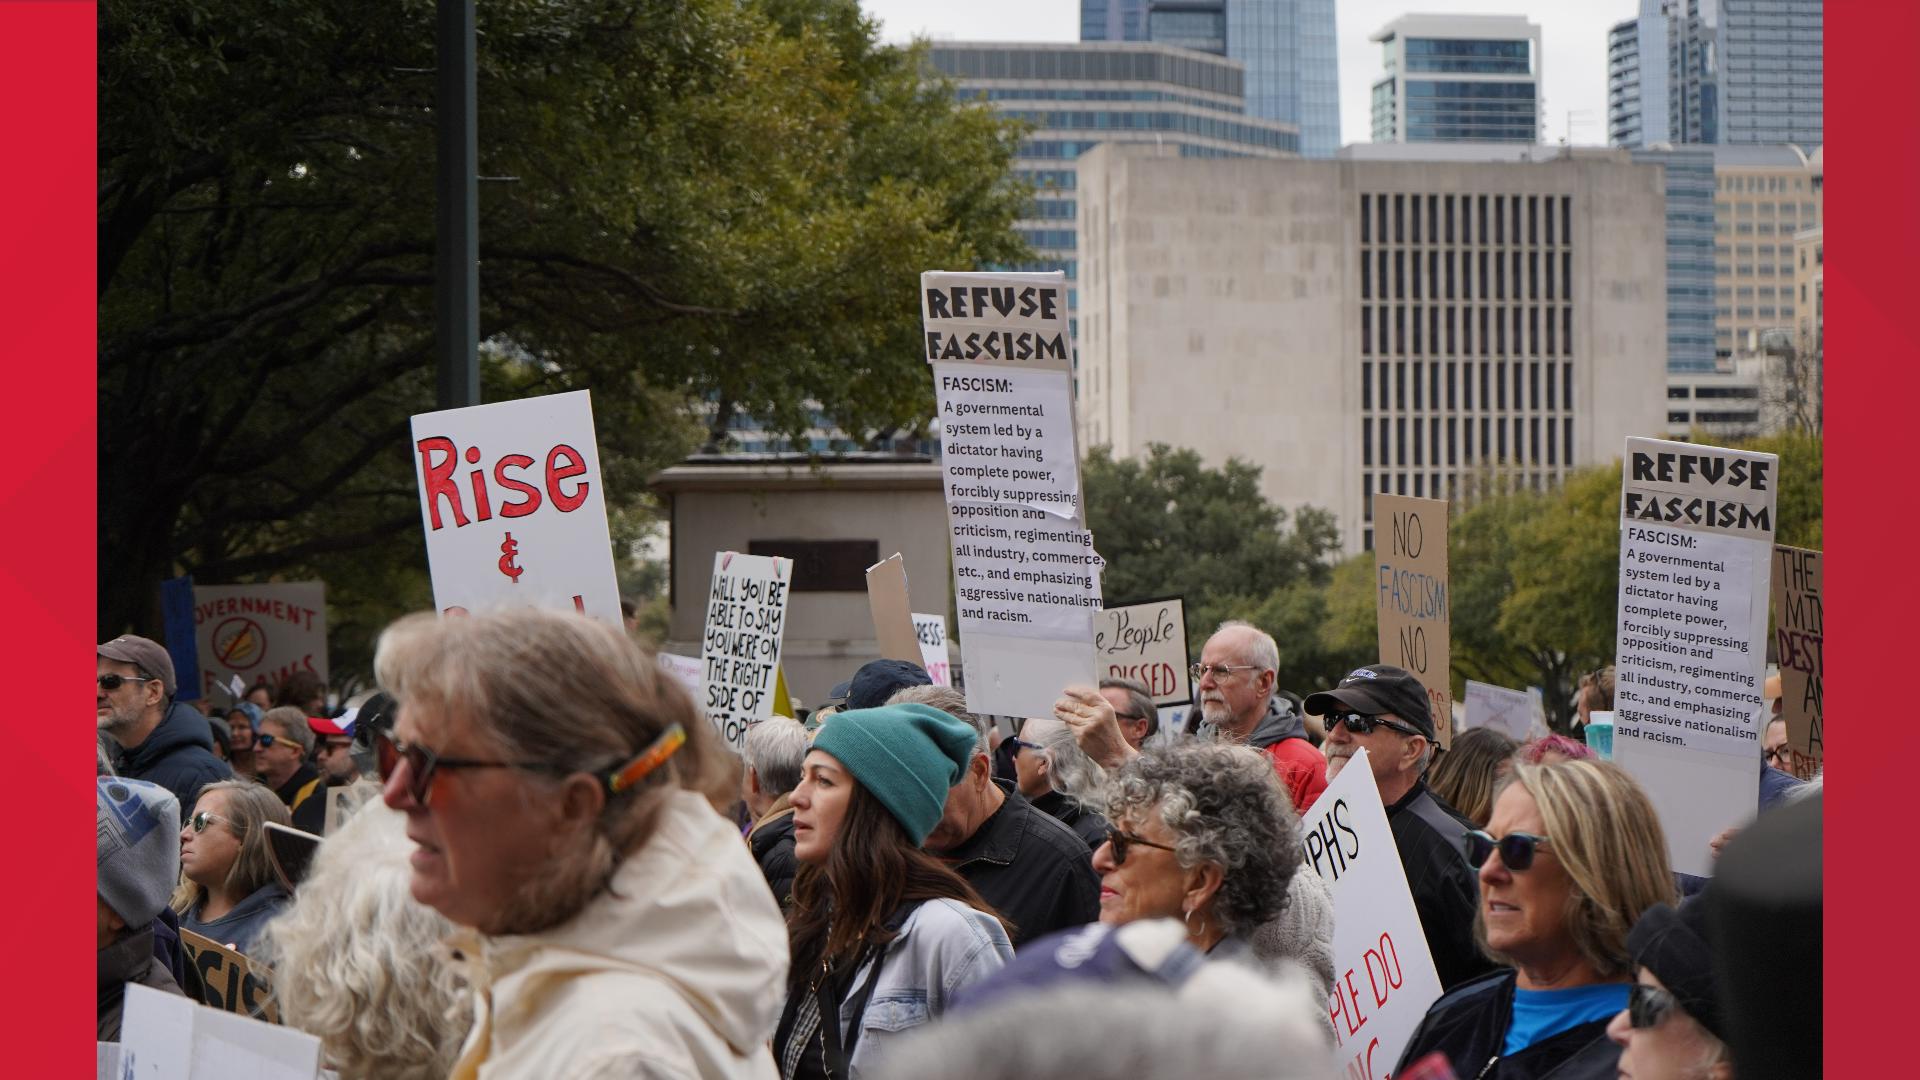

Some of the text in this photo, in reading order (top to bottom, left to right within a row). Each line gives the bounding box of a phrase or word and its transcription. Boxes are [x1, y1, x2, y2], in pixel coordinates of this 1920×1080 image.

[926, 286, 1057, 320] REFUSE
[927, 331, 1067, 360] FASCISM
[943, 376, 1014, 393] FASCISM:
[944, 400, 1044, 417] A governmental
[946, 423, 1043, 440] system led by a
[948, 442, 1043, 462] dictator having
[417, 436, 589, 530] Rise
[950, 466, 1055, 484] complete power,
[1632, 452, 1770, 490] REFUSE
[951, 484, 1077, 507] forcibly suppressing
[952, 504, 1046, 520] opposition and
[1626, 492, 1771, 532] FASCISM
[954, 524, 1092, 546] criticism, regimenting
[1392, 511, 1423, 558] NO
[1628, 527, 1698, 549] FASCISM:
[956, 544, 1105, 568] all industry, commerce,
[1626, 548, 1725, 573] A governmental
[958, 566, 1092, 590] etc., and emphasizing
[1626, 568, 1721, 591] system led by a
[1776, 548, 1818, 592] THE
[768, 580, 786, 607] BE
[960, 588, 1103, 608] aggressive nationalism
[1379, 564, 1446, 624] FASCISM
[1625, 584, 1718, 612] dictator having
[194, 598, 317, 631] OVERNMENT
[708, 602, 782, 636] ABLE TO SAY
[962, 608, 1032, 624] and racism.
[1624, 604, 1728, 630] complete power,
[706, 628, 780, 662] YOU WERE ON
[1622, 636, 1714, 660] opposition and
[1624, 620, 1749, 652] forcibly suppressing
[1400, 626, 1426, 674] NO
[706, 656, 728, 682] THE
[1622, 654, 1755, 688] criticism, regimenting
[742, 690, 764, 714] OF
[1620, 672, 1763, 707] all industry, commerce,
[1620, 690, 1751, 724] etc., and emphasizing
[1618, 726, 1686, 746] and racism.
[1619, 707, 1758, 740] aggressive nationalism
[1362, 932, 1402, 1010] DO
